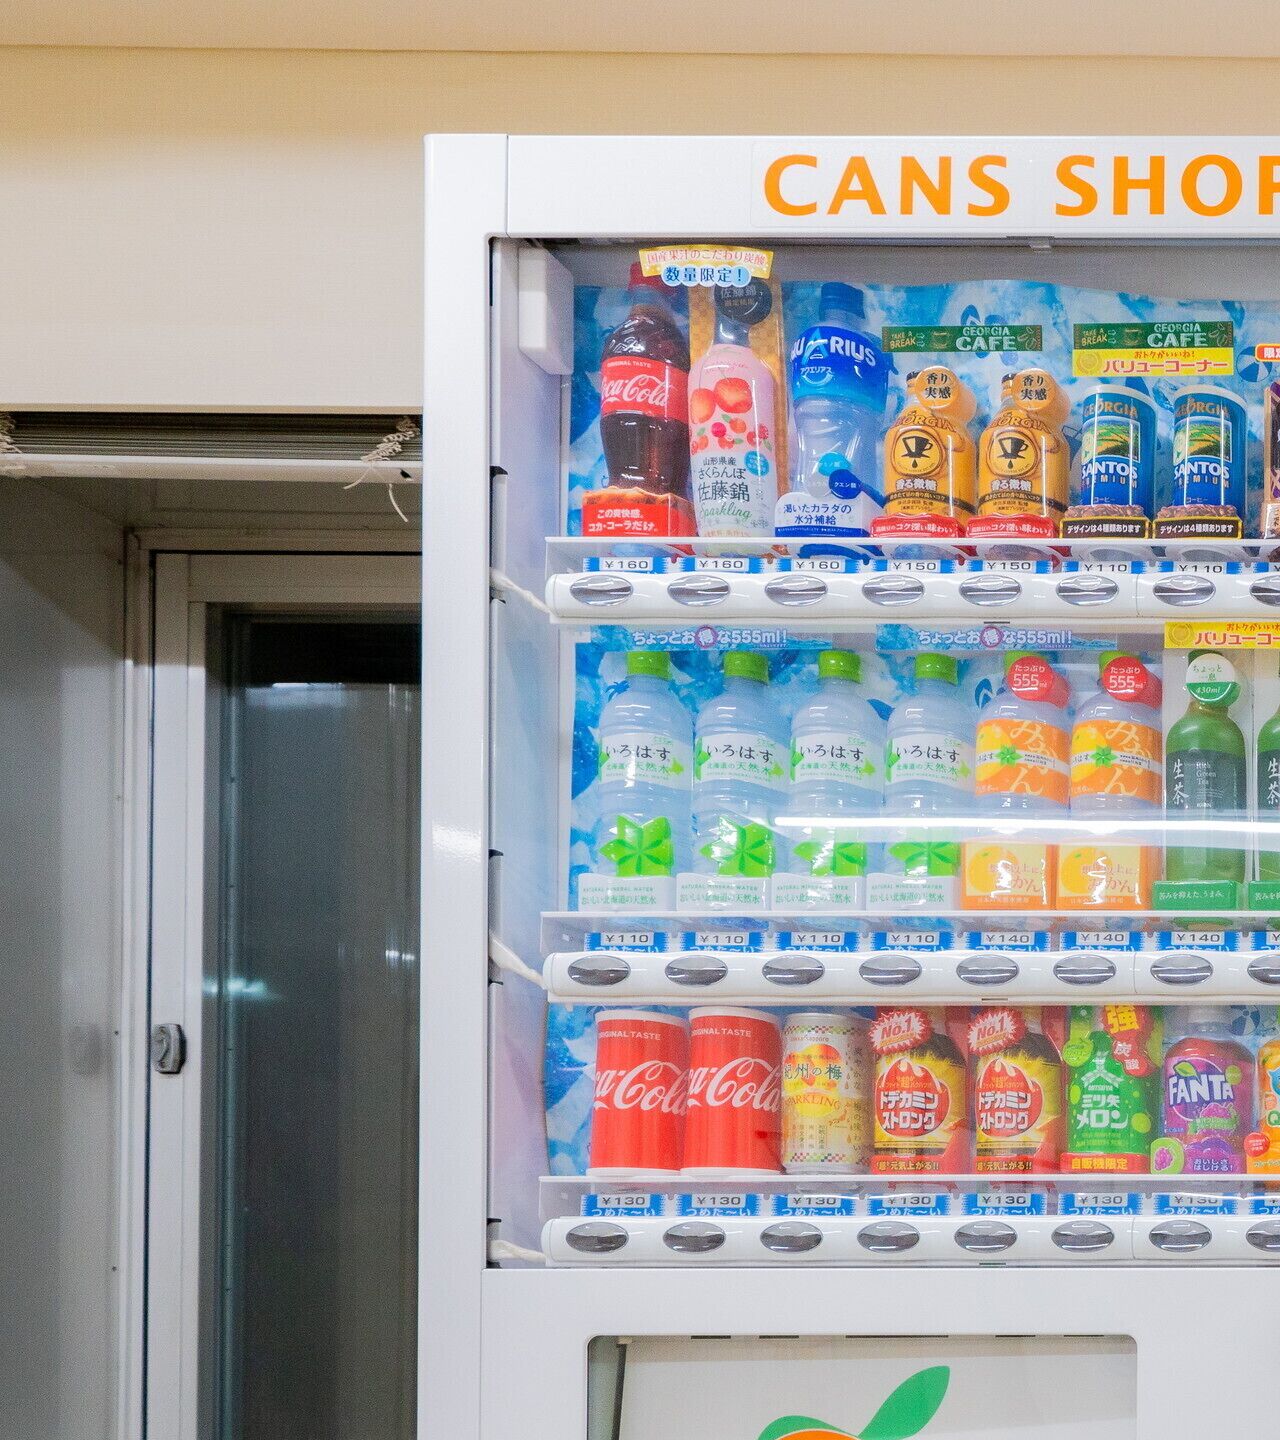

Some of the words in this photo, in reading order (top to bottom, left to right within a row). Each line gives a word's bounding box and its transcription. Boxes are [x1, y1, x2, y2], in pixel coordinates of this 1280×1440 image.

[764, 154, 1011, 216] CANS
[963, 326, 1010, 337] GEORGIA
[1154, 324, 1201, 332] GEORGIA
[956, 336, 1017, 351] CAFE
[1147, 333, 1207, 347] CAFE
[1103, 360, 1228, 373] バリューコーナー
[703, 456, 737, 466] 山形県産
[699, 466, 746, 480] さくらんぼ
[1081, 462, 1138, 480] SANTOS
[1174, 462, 1230, 480] SANTOS
[698, 481, 750, 502] 佐藤錦
[783, 503, 851, 515] 渇いたカラダの
[794, 515, 836, 525] 水分補給
[605, 560, 649, 569] ¥160
[796, 561, 840, 570] ¥160
[986, 561, 1031, 570] ¥150
[1014, 664, 1045, 672] たっぷり
[1110, 666, 1141, 674] たっぷり
[606, 934, 649, 943] ¥110
[797, 934, 840, 943] ¥110
[986, 934, 1030, 943] ¥140
[1177, 934, 1220, 942] ¥140
[1106, 1004, 1139, 1034] 強
[1169, 1074, 1234, 1106] FANTA
[1076, 1109, 1128, 1129] メロン
[1072, 1158, 1128, 1170] 自販機限定
[602, 1197, 645, 1205] ¥130
[983, 1196, 1026, 1204] ¥130
